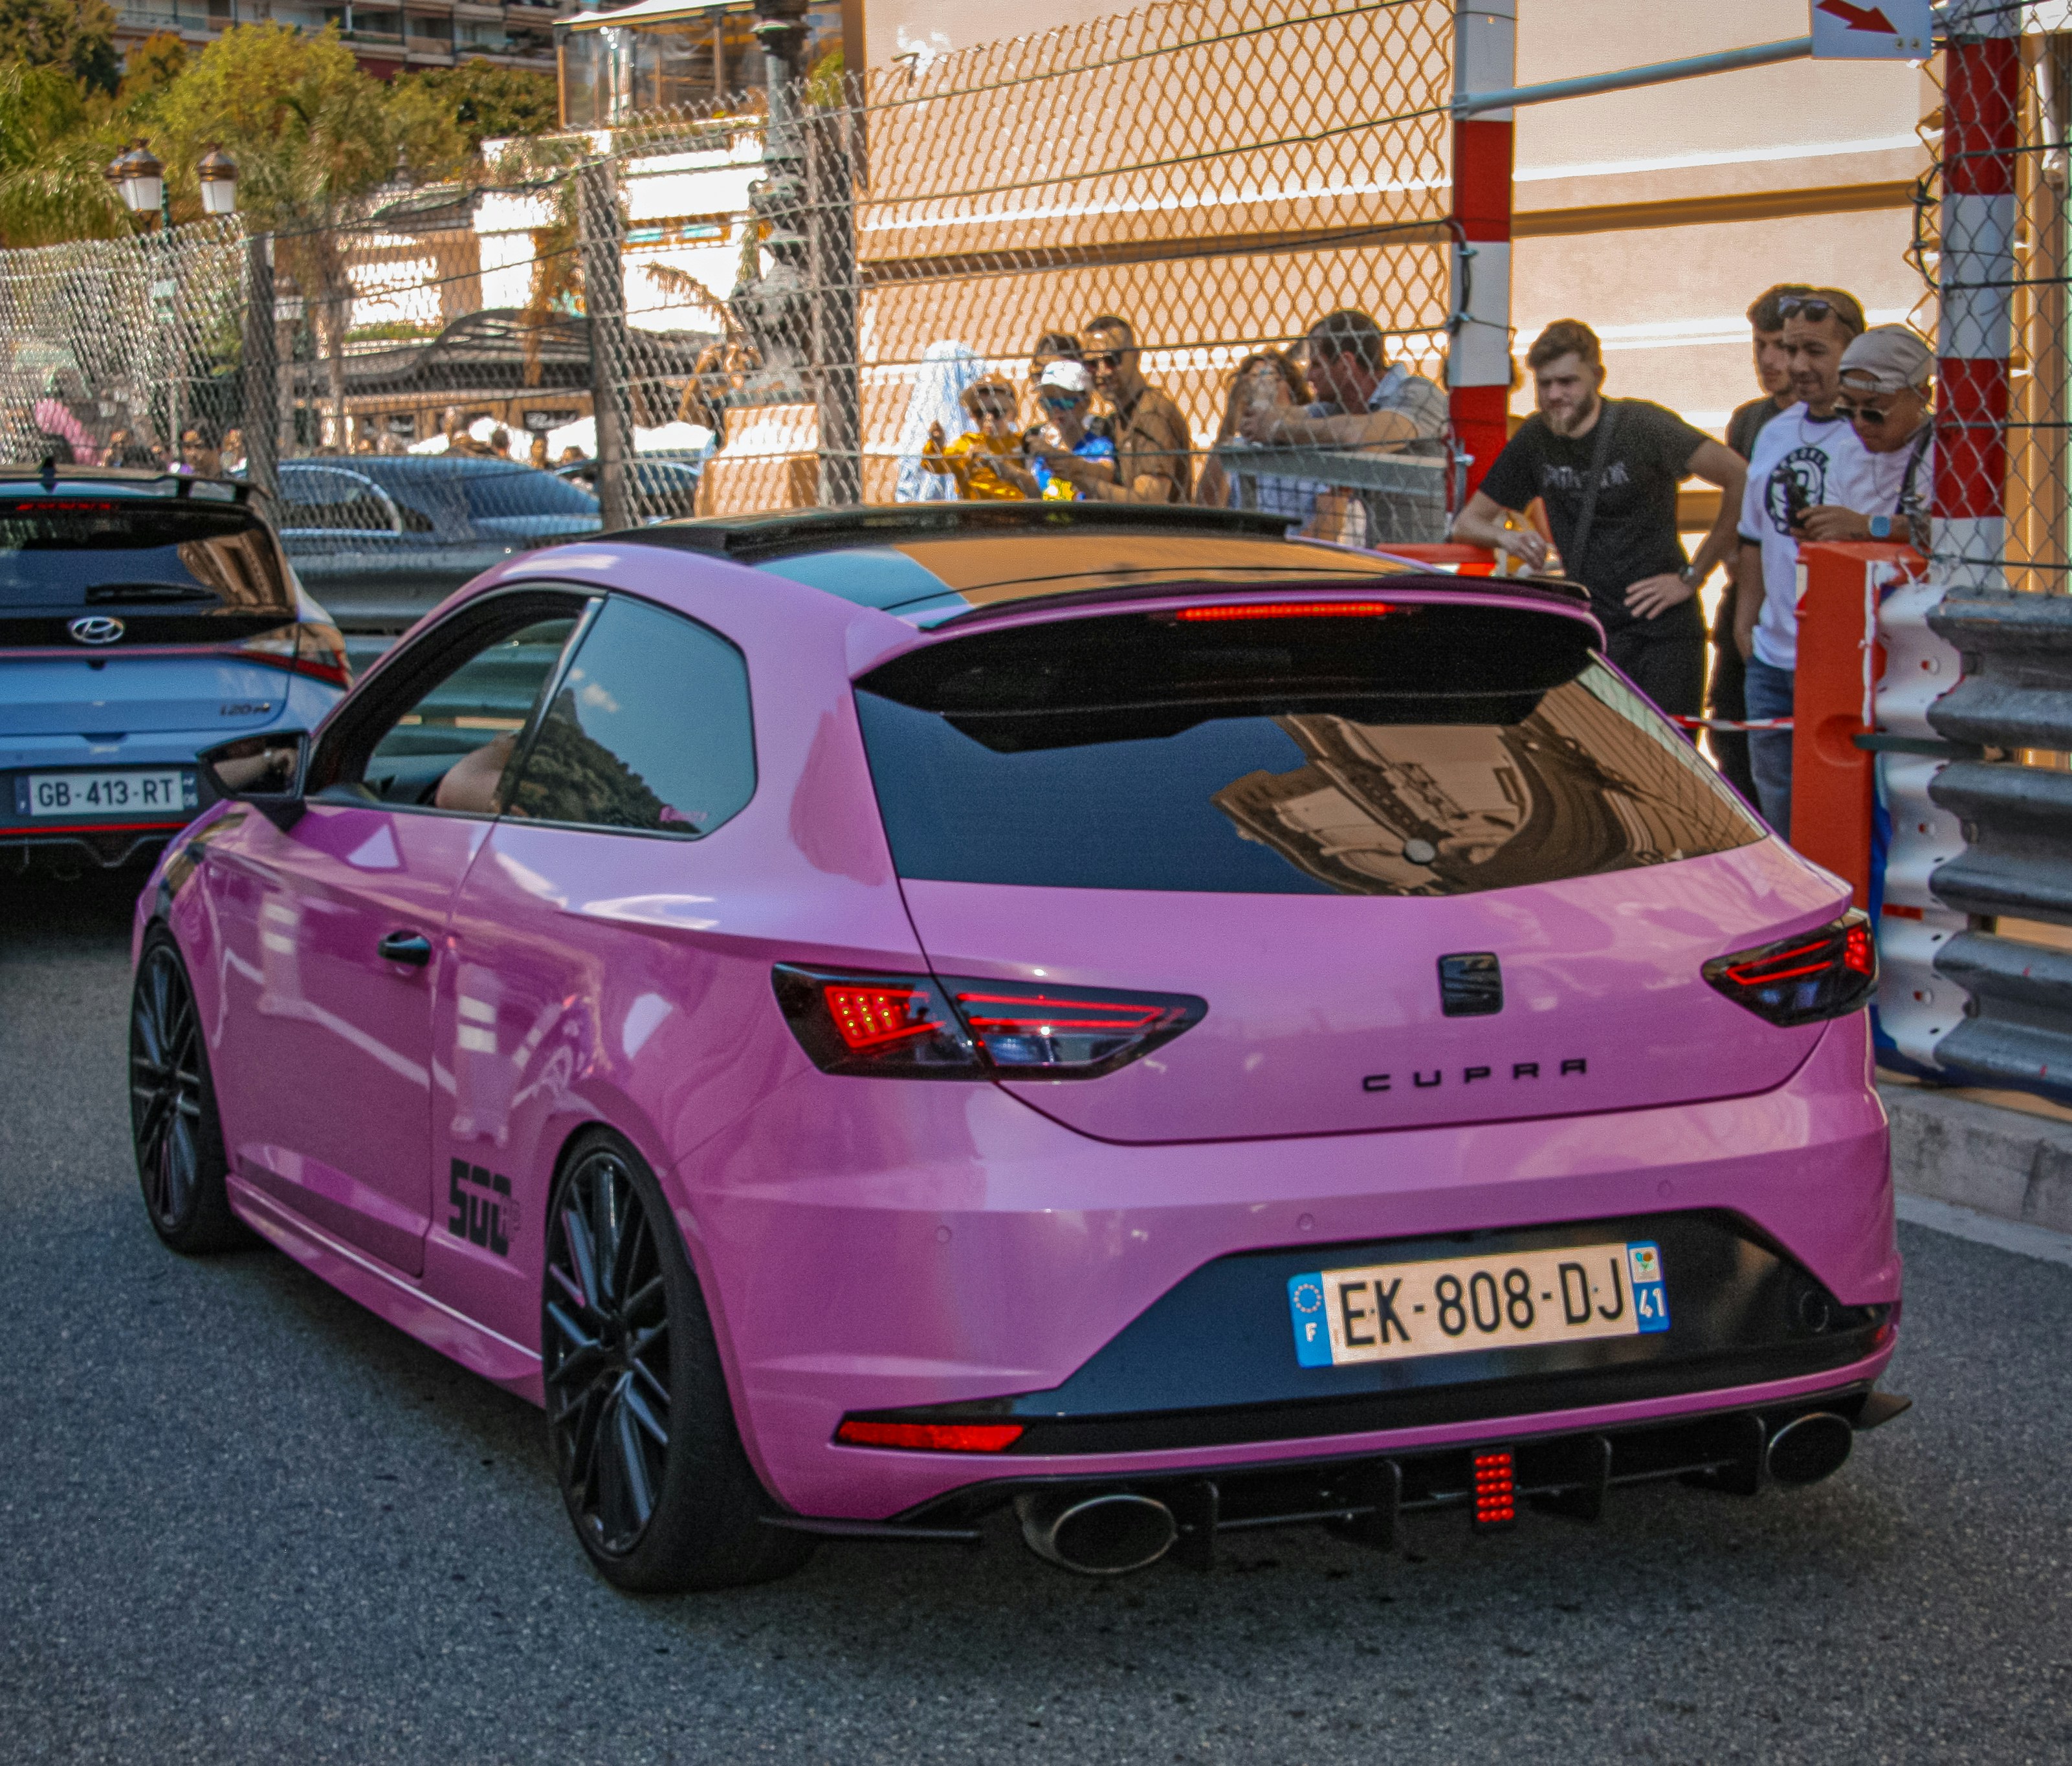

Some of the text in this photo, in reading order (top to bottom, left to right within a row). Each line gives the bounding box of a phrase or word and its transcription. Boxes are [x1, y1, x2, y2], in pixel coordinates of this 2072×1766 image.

[38, 778, 173, 808] GB-413-RT
[1361, 1058, 1587, 1093] CUPRA
[1338, 1257, 1626, 1348] EK-808-DJ
[1637, 1287, 1667, 1319] 41
[1305, 1322, 1319, 1343] F
